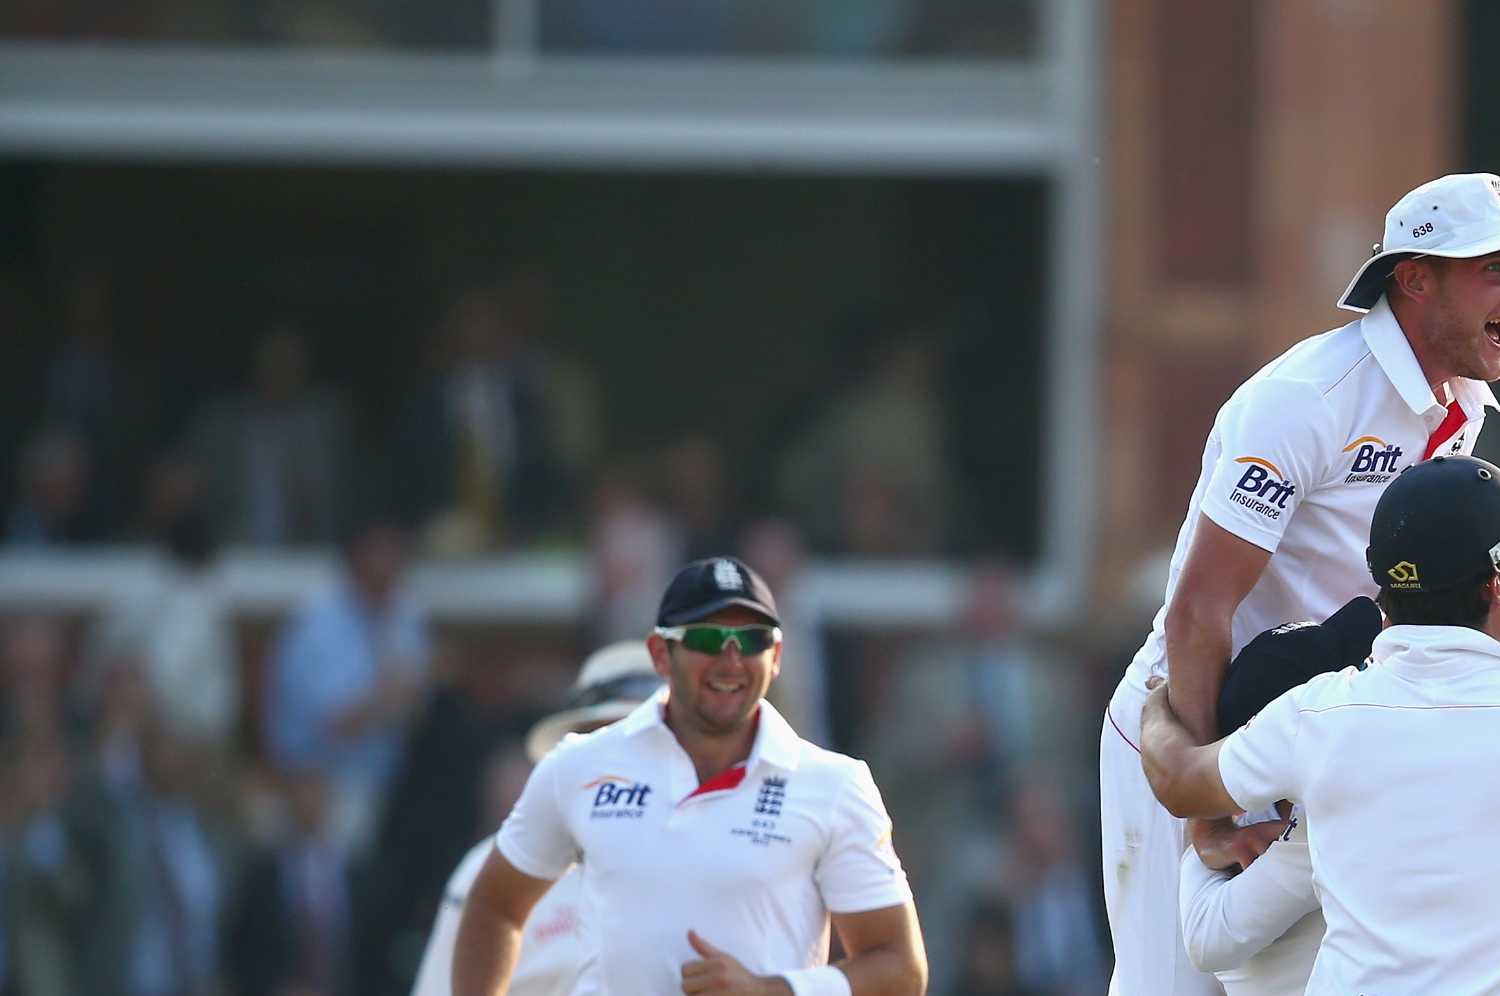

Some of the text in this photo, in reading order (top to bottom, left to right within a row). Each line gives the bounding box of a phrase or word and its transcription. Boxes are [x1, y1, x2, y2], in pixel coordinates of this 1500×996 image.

[1412, 222, 1434, 238] 638
[1350, 444, 1403, 473] Brit
[1236, 464, 1296, 509] Brit
[1229, 488, 1281, 520] Insurance
[594, 782, 652, 807] Brit
